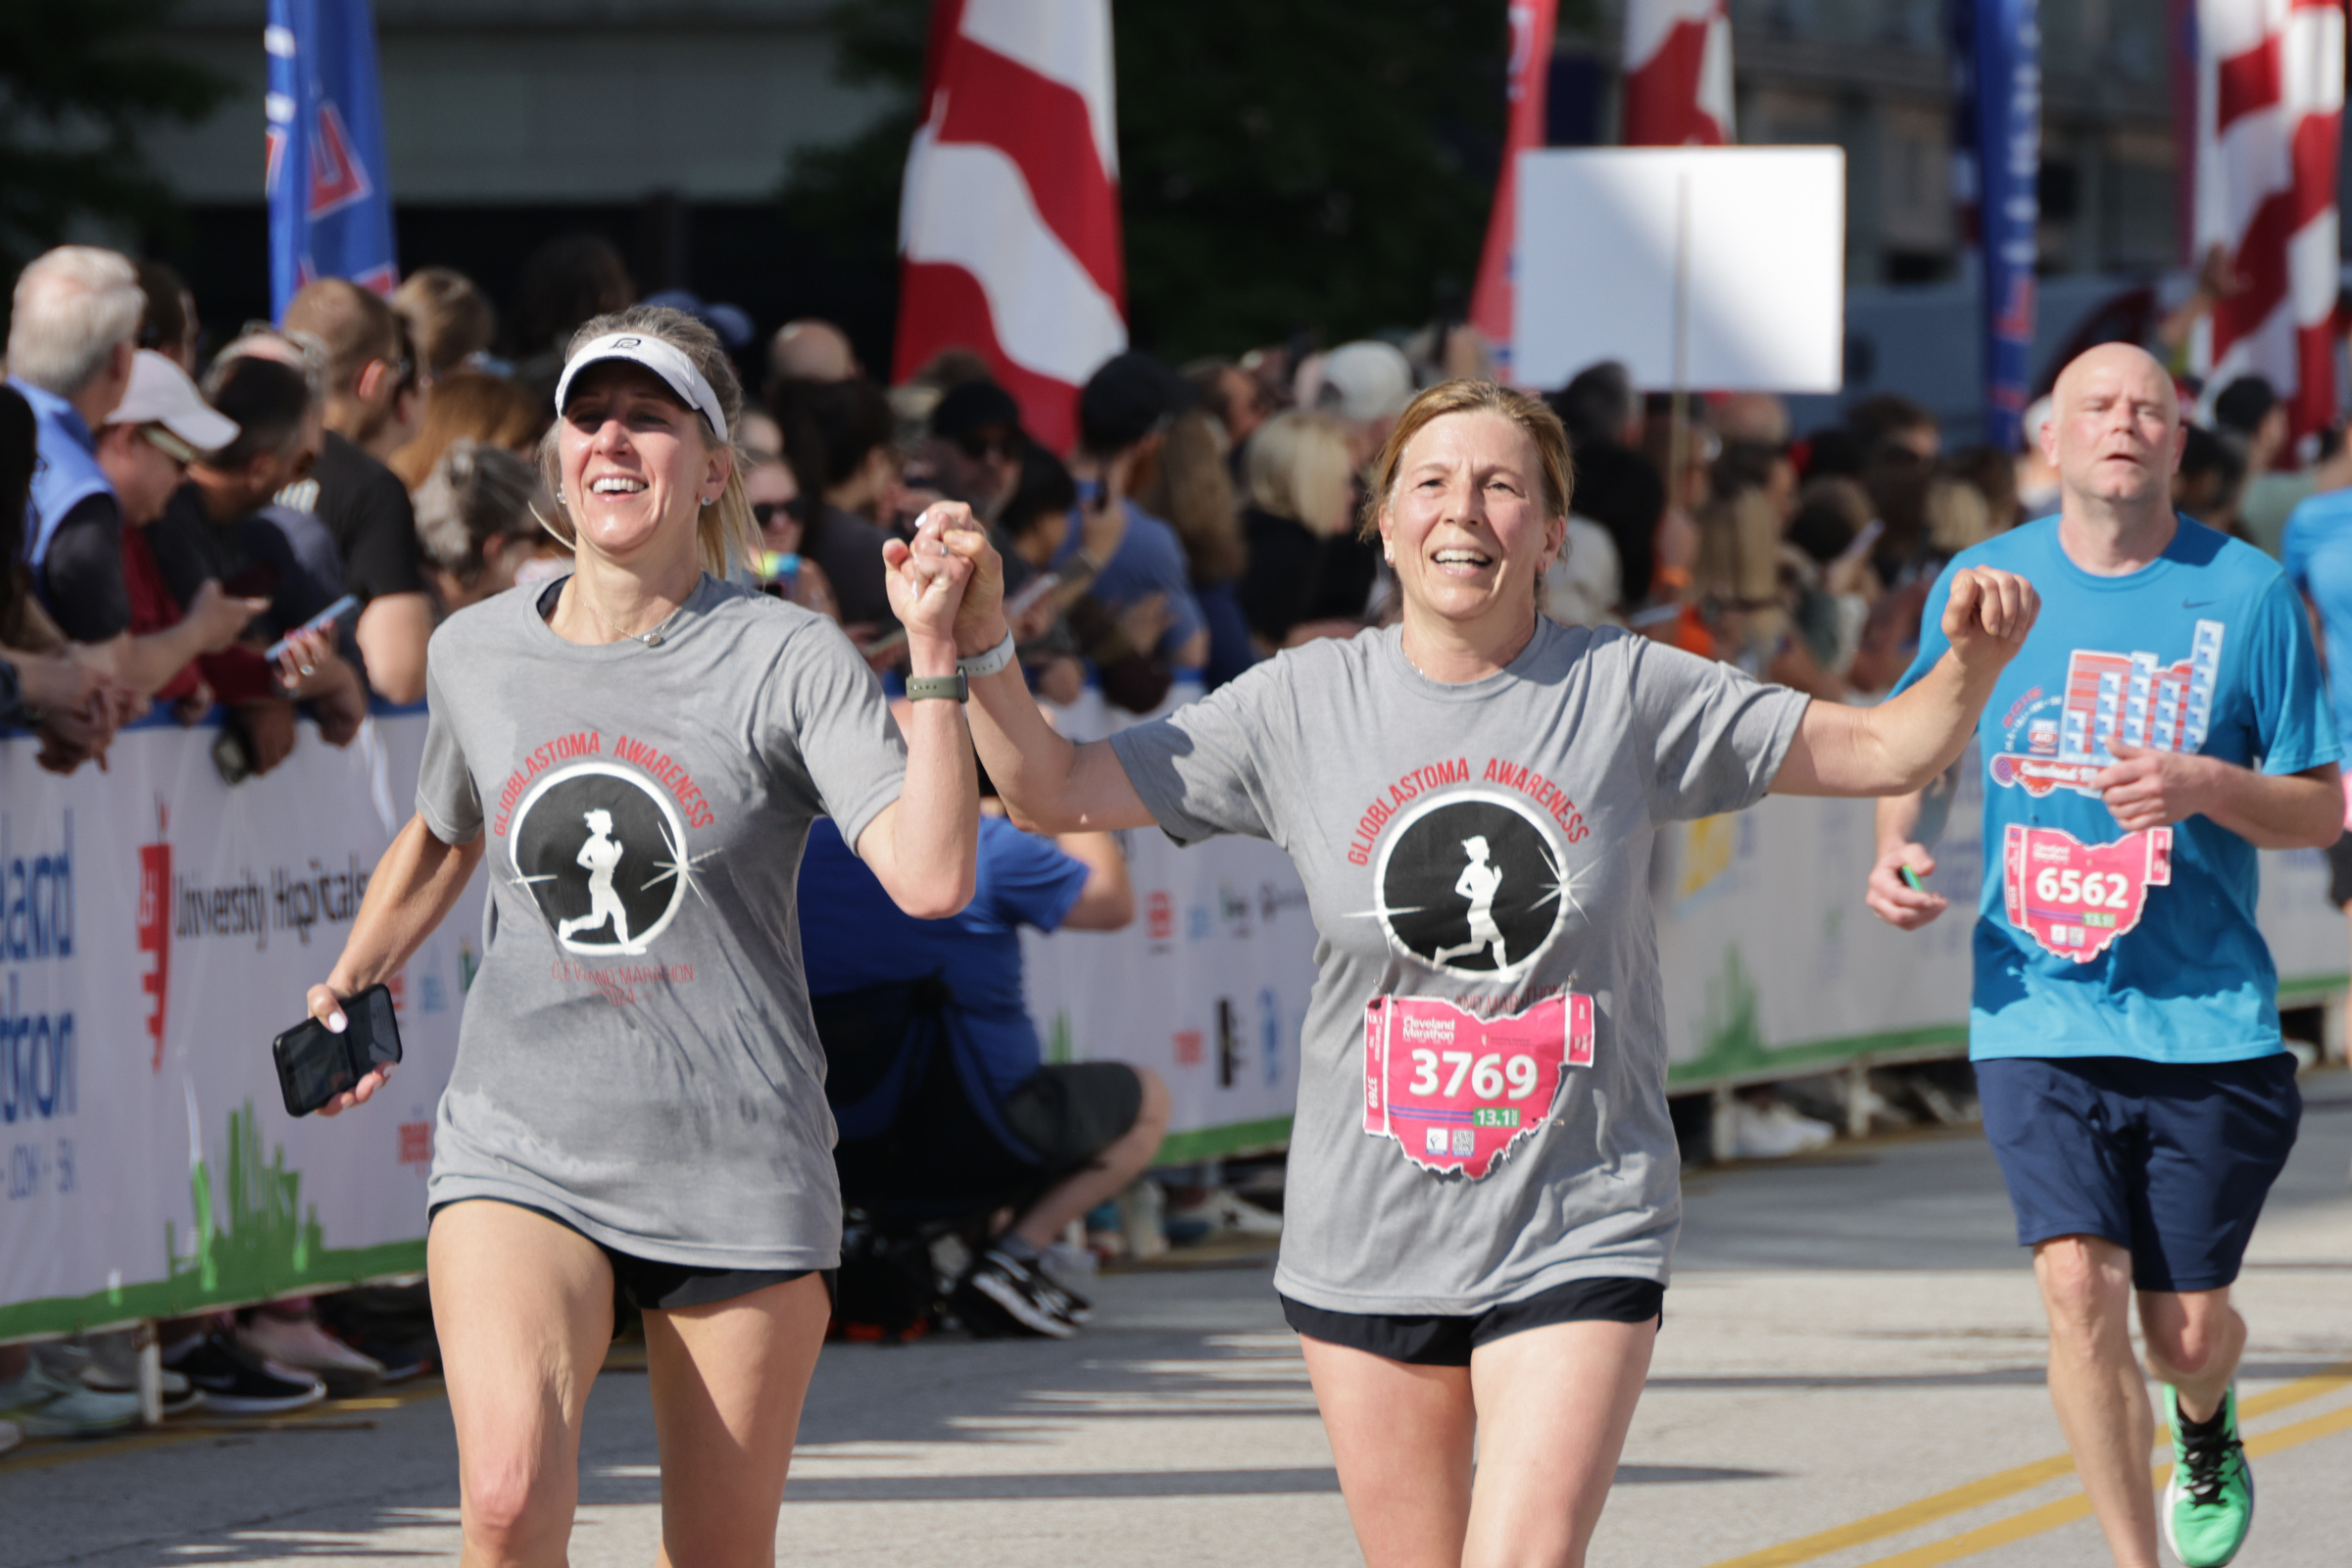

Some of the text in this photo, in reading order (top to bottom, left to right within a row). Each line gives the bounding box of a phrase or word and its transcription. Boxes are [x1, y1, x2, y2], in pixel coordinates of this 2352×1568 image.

[494, 730, 715, 837] GLIOBLASTOMA AWARENESS
[1347, 757, 1591, 867] GLIOBLASTOMA AWARENESS
[2035, 866, 2130, 909] 6562
[2083, 913, 2109, 927] 13.1
[1402, 1015, 1455, 1031] Cleveland
[1402, 1026, 1455, 1041] Marathon
[1408, 1048, 1539, 1101] 3769
[1367, 1075, 1379, 1109] 3769
[1476, 1108, 1511, 1127] 13.1
